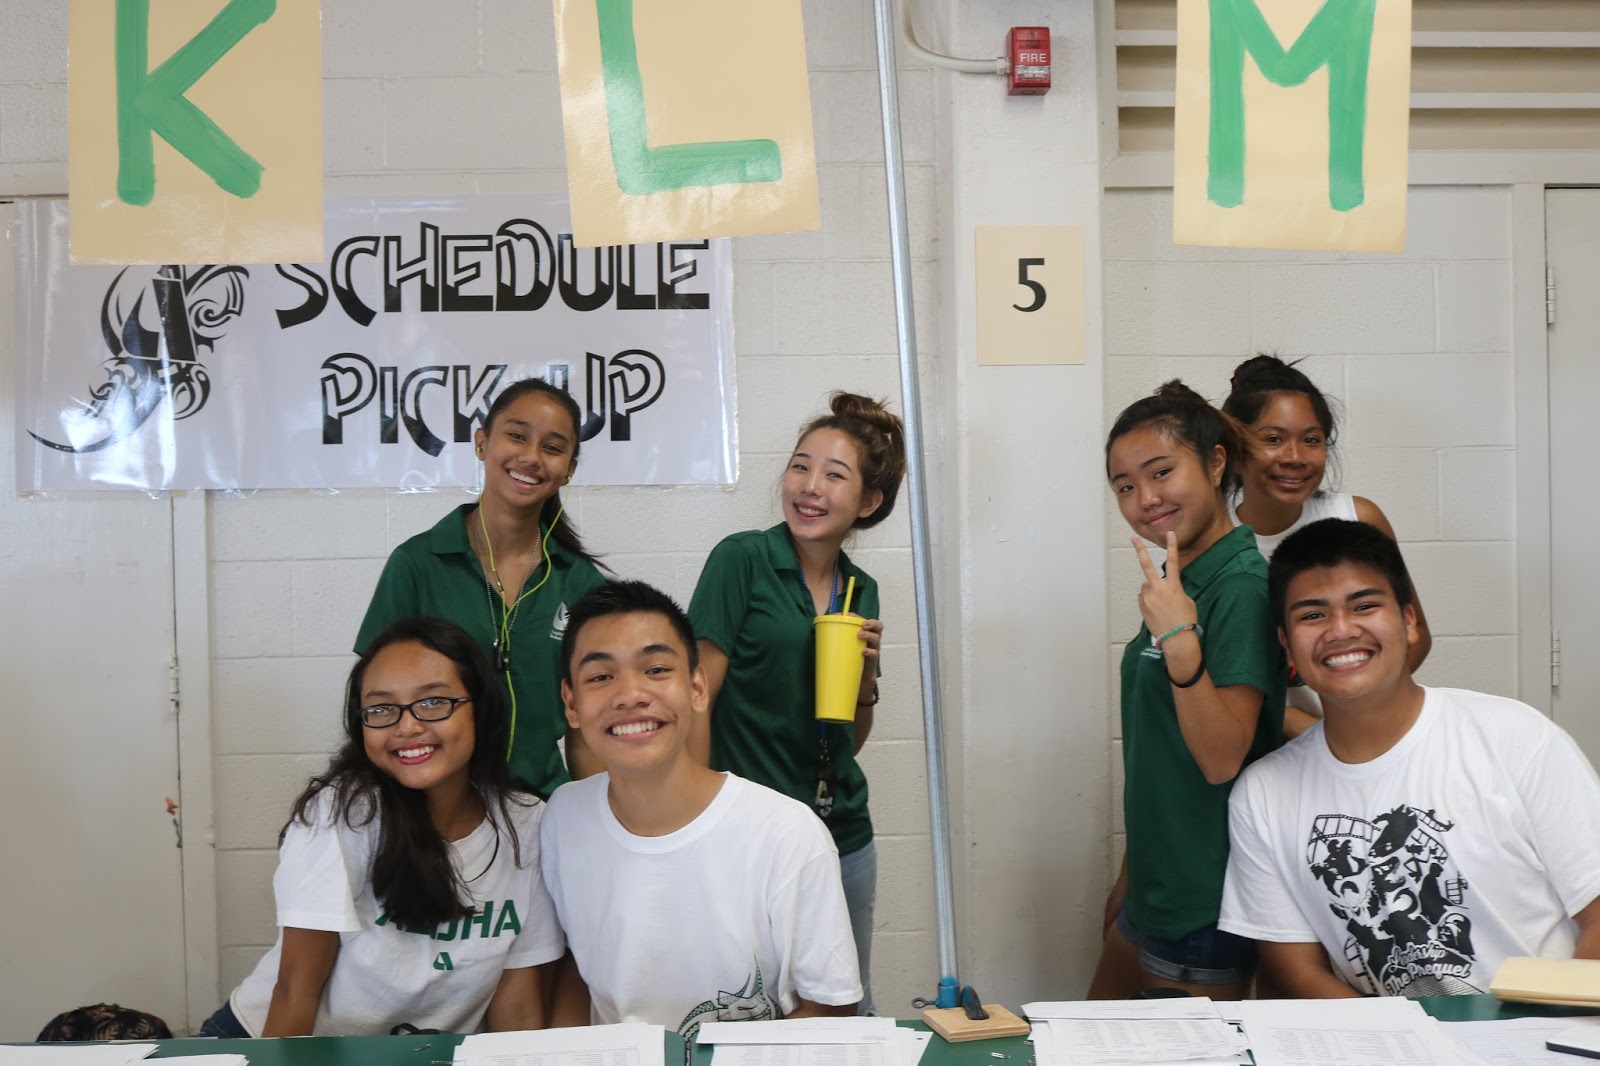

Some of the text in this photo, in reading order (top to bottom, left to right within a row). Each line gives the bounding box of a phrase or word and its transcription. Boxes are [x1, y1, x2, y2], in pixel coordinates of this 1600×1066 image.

[116, 0, 277, 206] K
[598, 0, 781, 195] L
[1020, 53, 1047, 63] FIRE
[1207, 0, 1376, 212] M
[275, 218, 710, 329] SCHEDULE
[1012, 257, 1047, 312] 5
[320, 352, 507, 457] PICK
[1385, 961, 1472, 996] The Prequel
